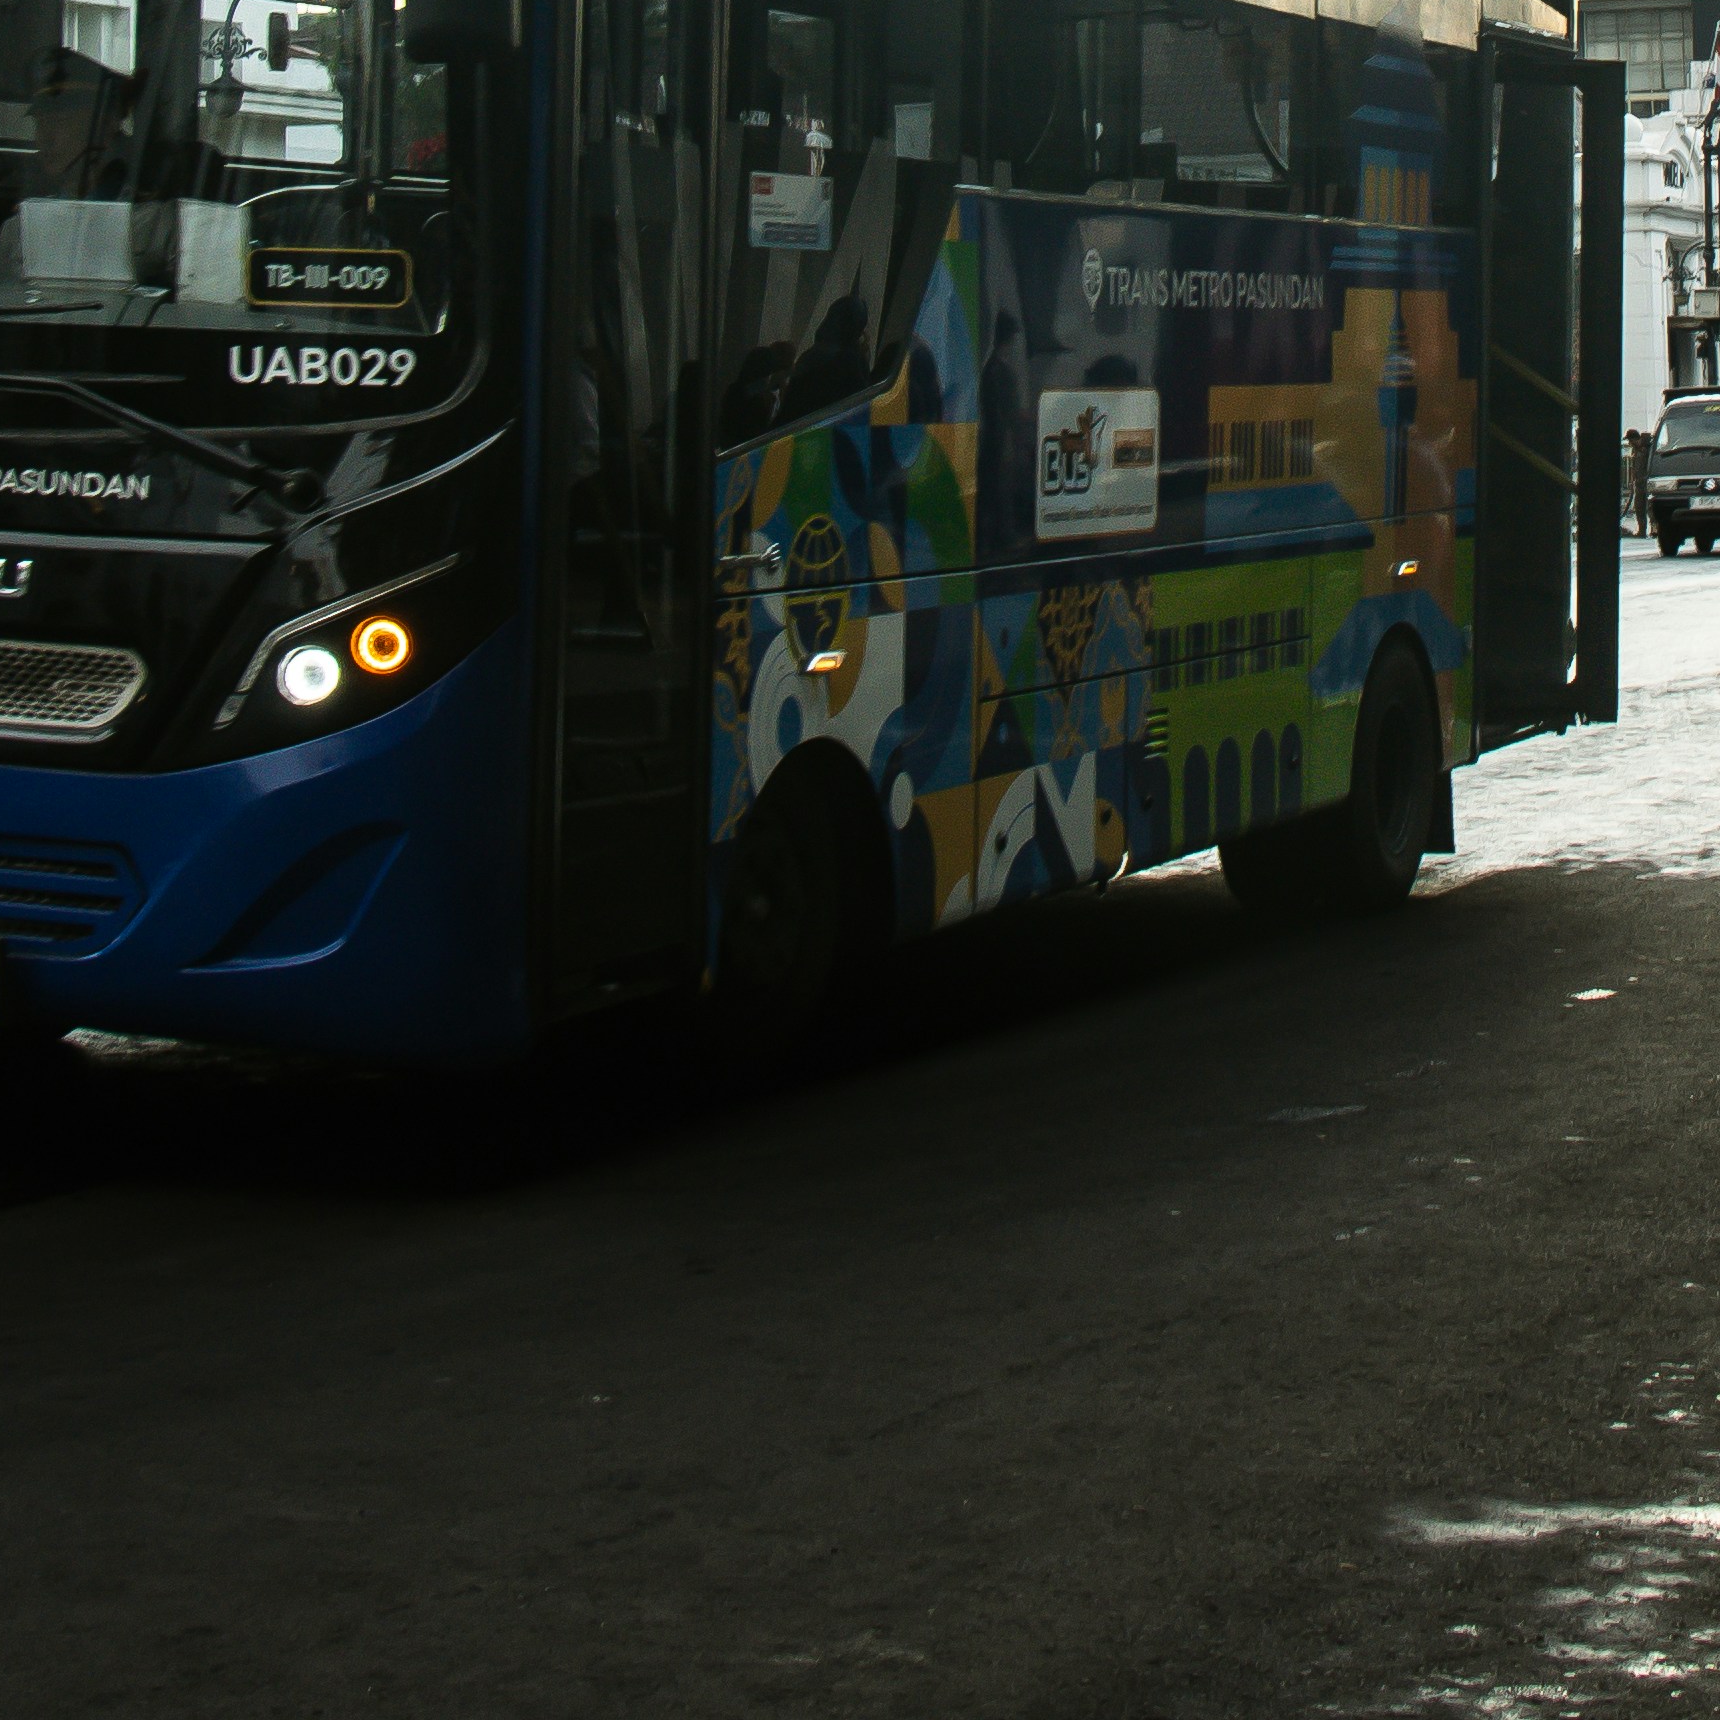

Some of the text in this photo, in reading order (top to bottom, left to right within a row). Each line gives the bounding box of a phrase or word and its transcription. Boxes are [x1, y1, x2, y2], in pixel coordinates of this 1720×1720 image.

[1106, 266, 1325, 310] TRANS METRO PASUNDAN
[229, 345, 418, 388] UAB029
